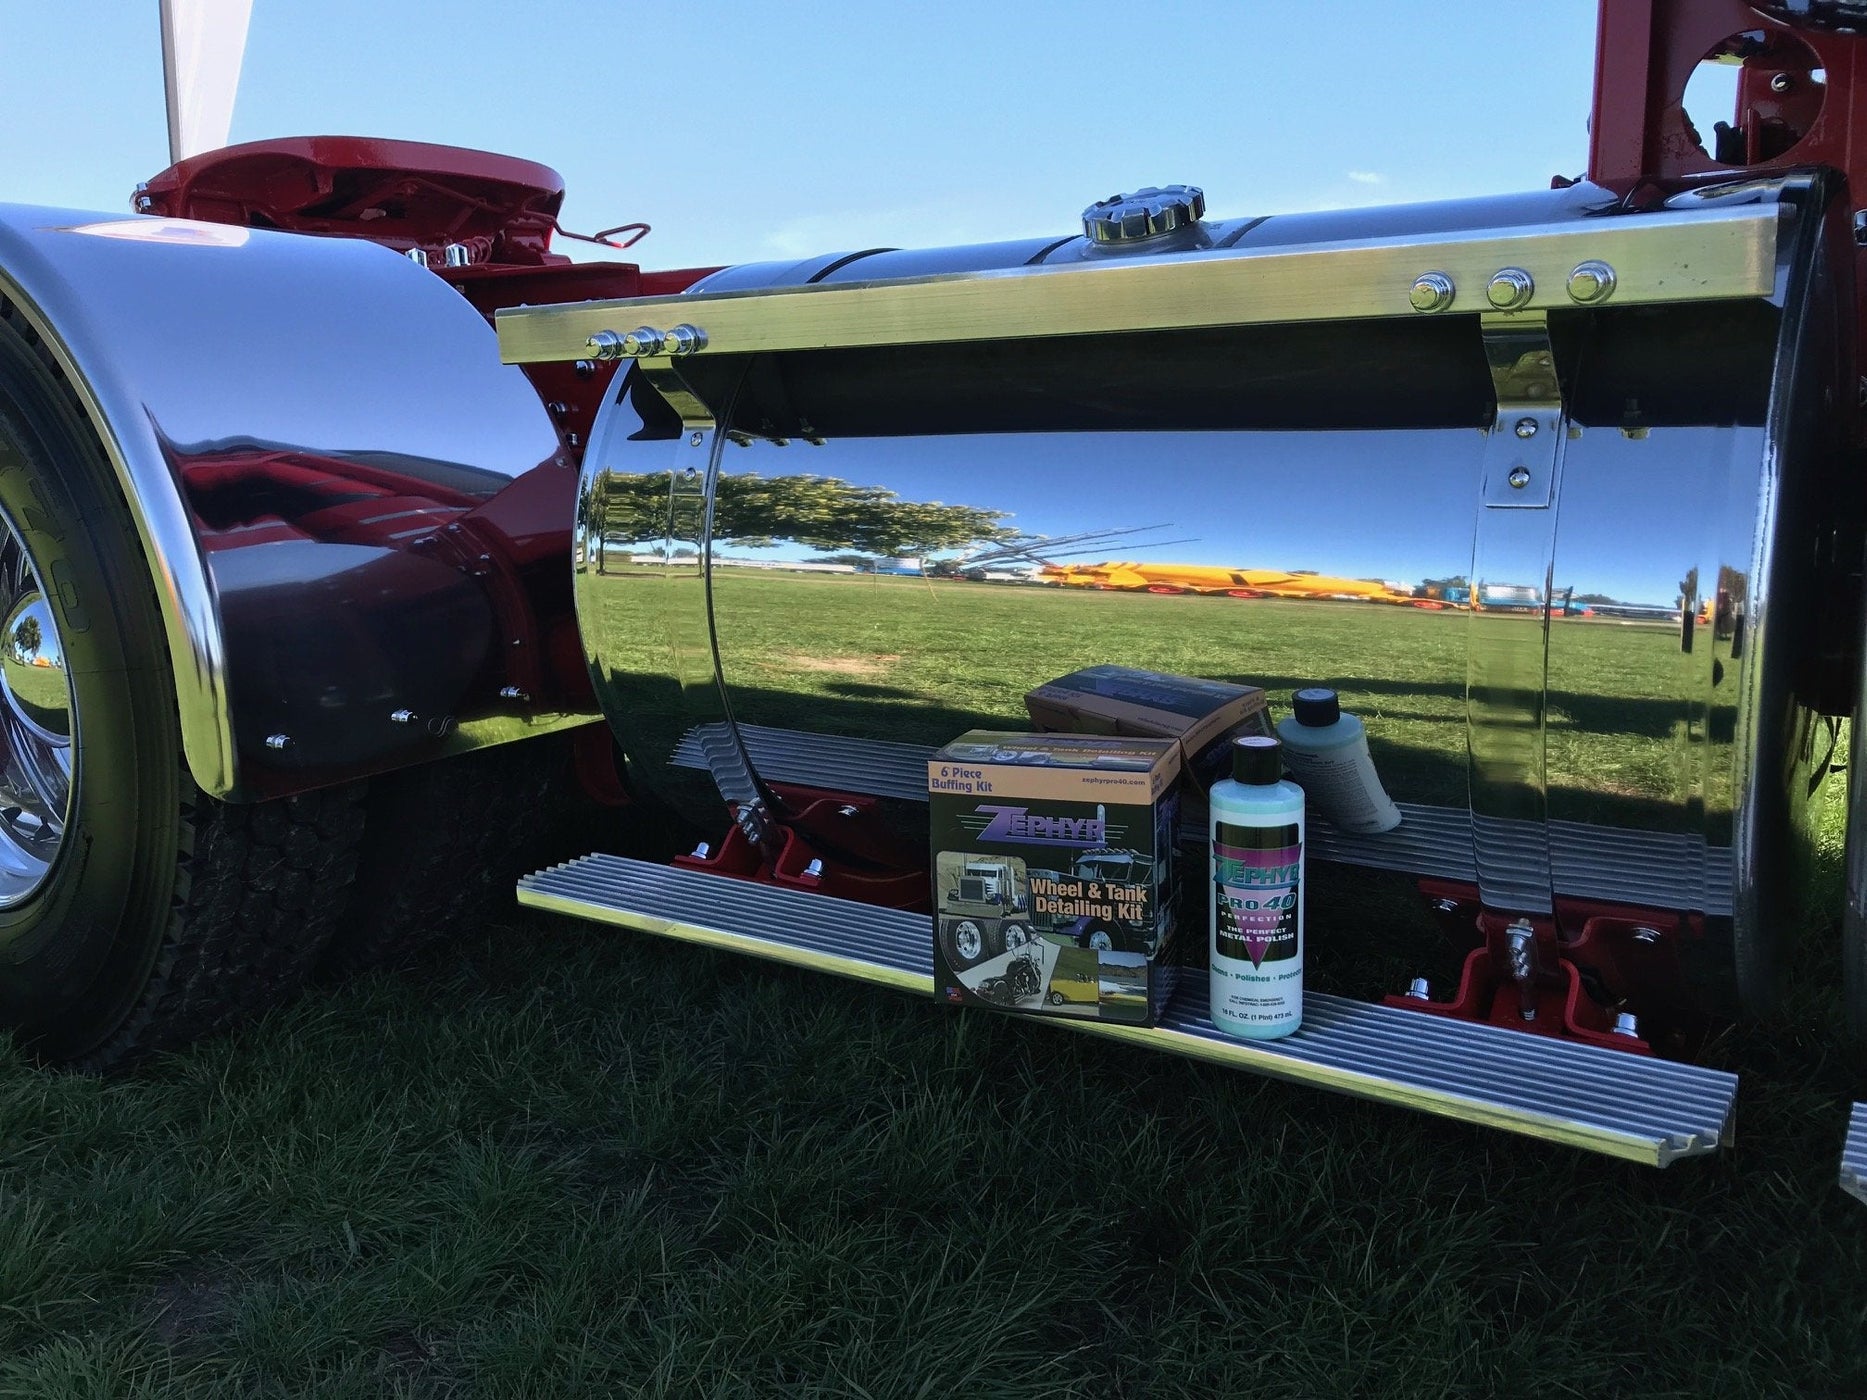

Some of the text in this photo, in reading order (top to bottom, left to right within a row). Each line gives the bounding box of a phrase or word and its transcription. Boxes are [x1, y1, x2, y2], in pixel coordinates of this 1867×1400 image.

[941, 767, 982, 779] 6 Piece
[931, 778, 993, 793] Buffing Kit
[1082, 776, 1146, 786] zephyrpro40.com
[974, 804, 1108, 848] ZEPHYR
[1212, 854, 1301, 890] ZEPHYR
[1030, 878, 1148, 902] Wheel & Tank
[1217, 892, 1297, 911] PRO 40
[1036, 896, 1144, 921] Detailing Kit
[1221, 911, 1292, 922] PERFECTION
[1220, 930, 1294, 942] METAL POLISH
[1227, 925, 1287, 935] THE PERFECT
[1235, 973, 1270, 982] Polishes
[1239, 1012, 1249, 1020] OZ.
